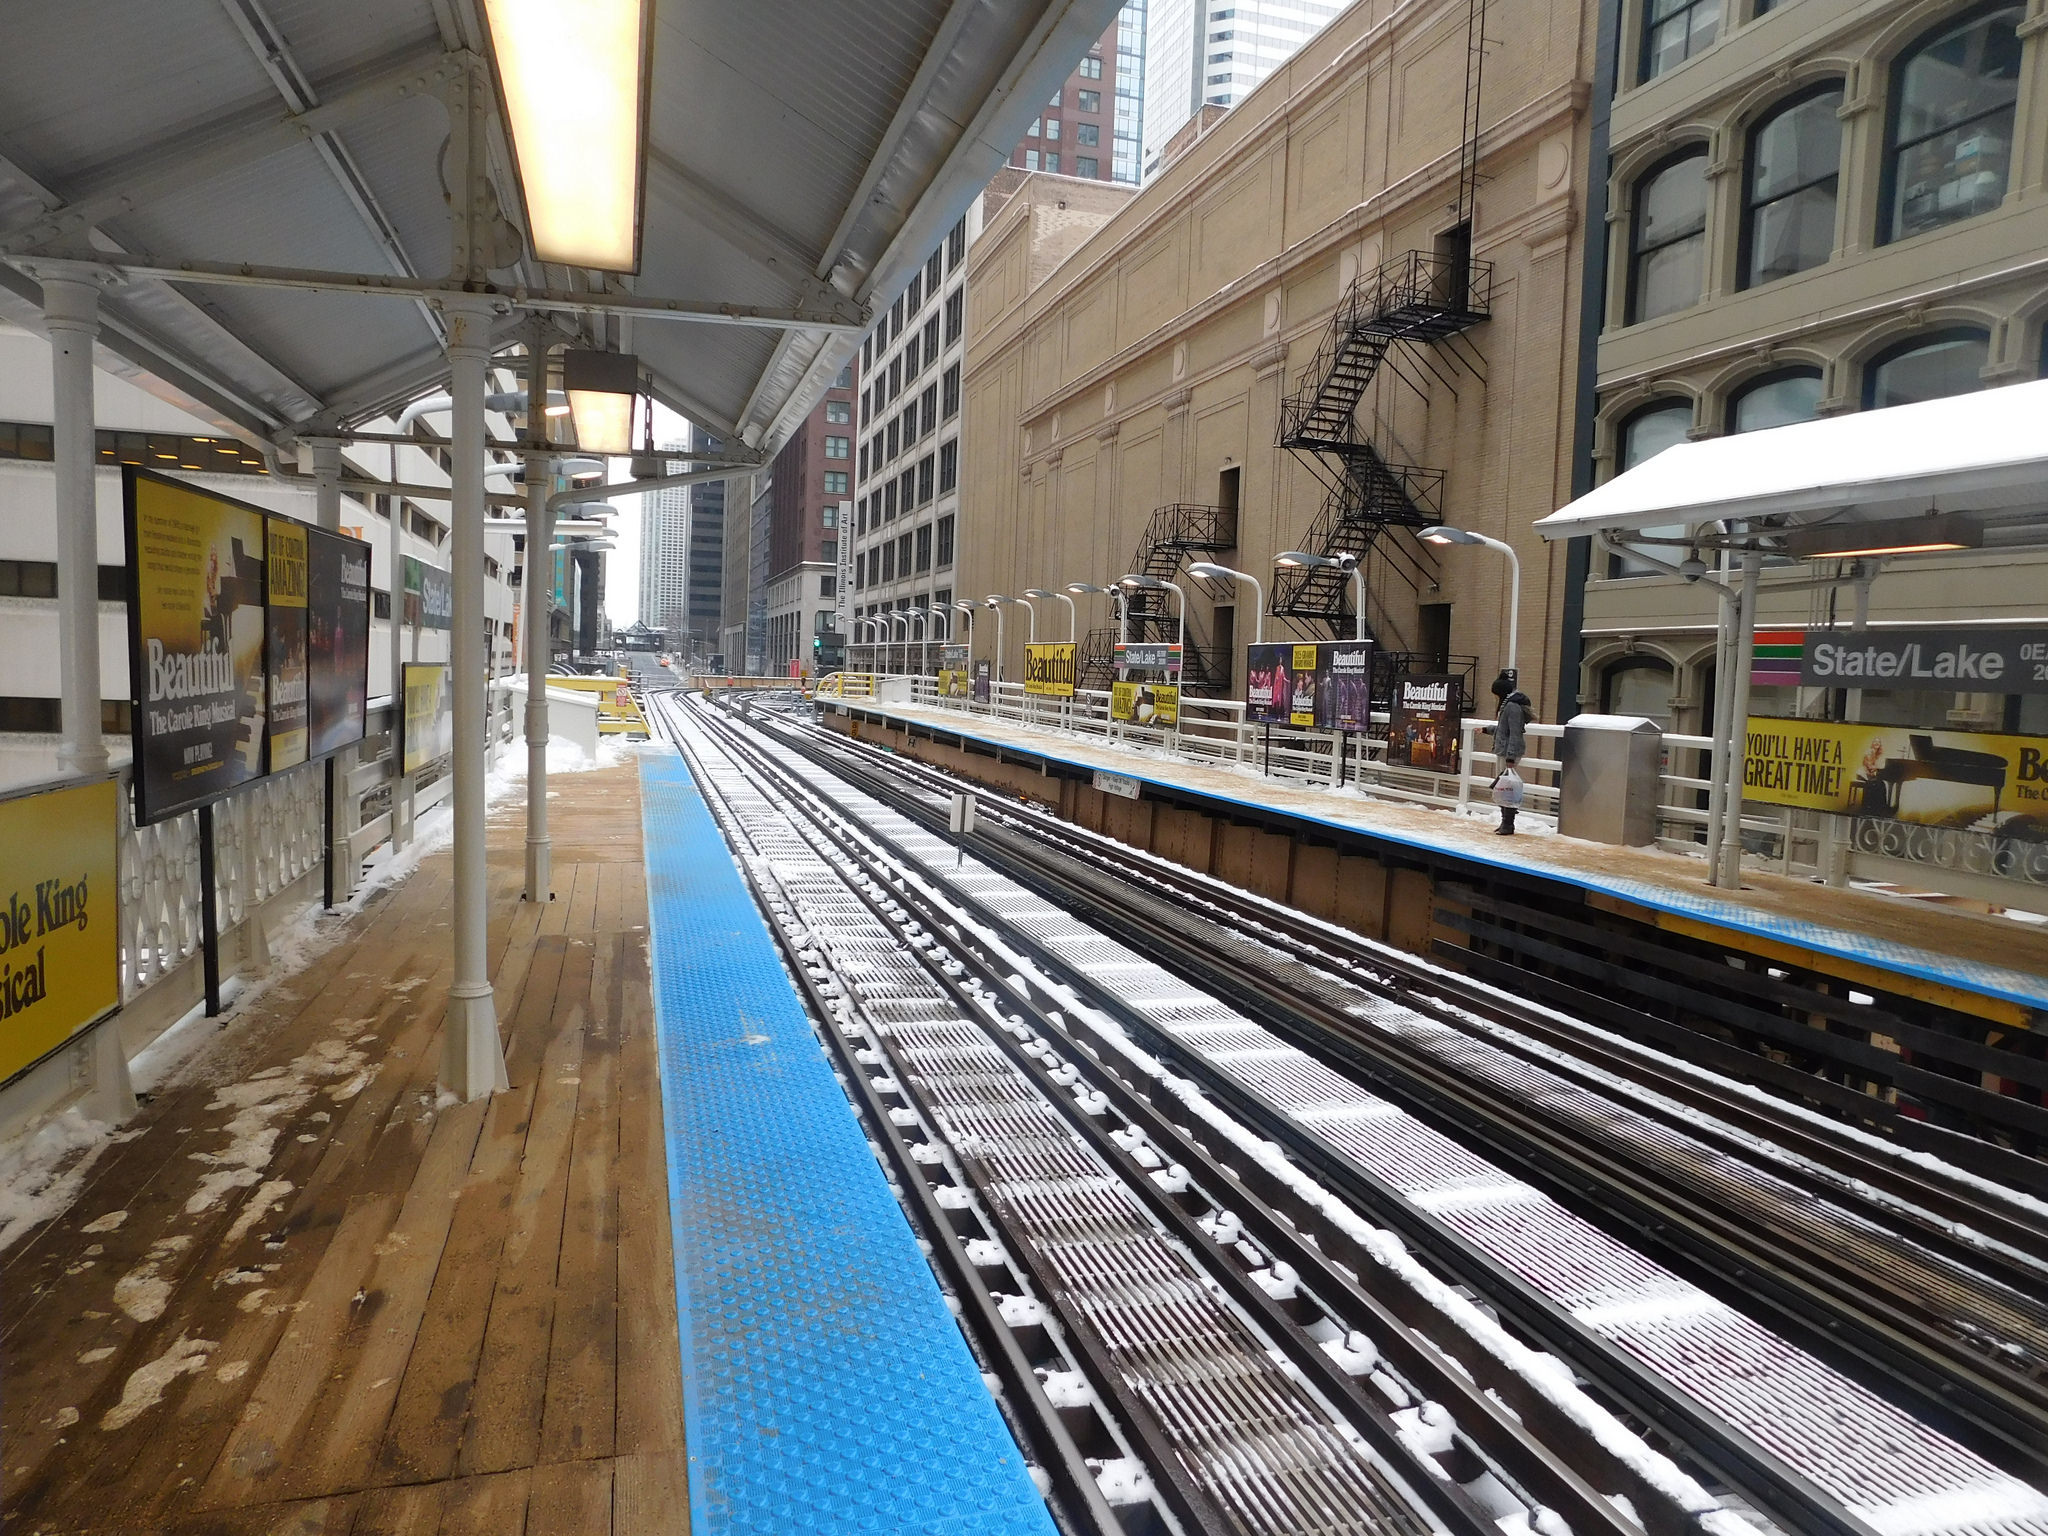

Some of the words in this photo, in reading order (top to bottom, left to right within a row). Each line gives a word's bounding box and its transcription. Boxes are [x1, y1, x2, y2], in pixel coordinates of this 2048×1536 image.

[841, 526, 848, 534] of
[147, 636, 235, 702] Beautiful
[1026, 648, 1074, 684] Beautiful
[1125, 650, 1156, 665] State/Lake
[1333, 650, 1366, 666] Beautiful
[1812, 643, 2005, 680] State/Lake
[1249, 684, 1273, 699] Beautiful
[1403, 682, 1449, 701] Beautiful
[149, 711, 167, 736] The
[168, 703, 193, 733] Carole
[193, 704, 211, 730] King
[211, 699, 236, 724] Musical
[1747, 733, 1788, 759] YOU'LL
[1794, 737, 1831, 763] HAVE
[1833, 740, 1842, 764] A
[1744, 757, 1793, 791] GREAT
[2016, 784, 2040, 800] The
[36, 873, 88, 937] King
[0, 946, 46, 1022] ical
